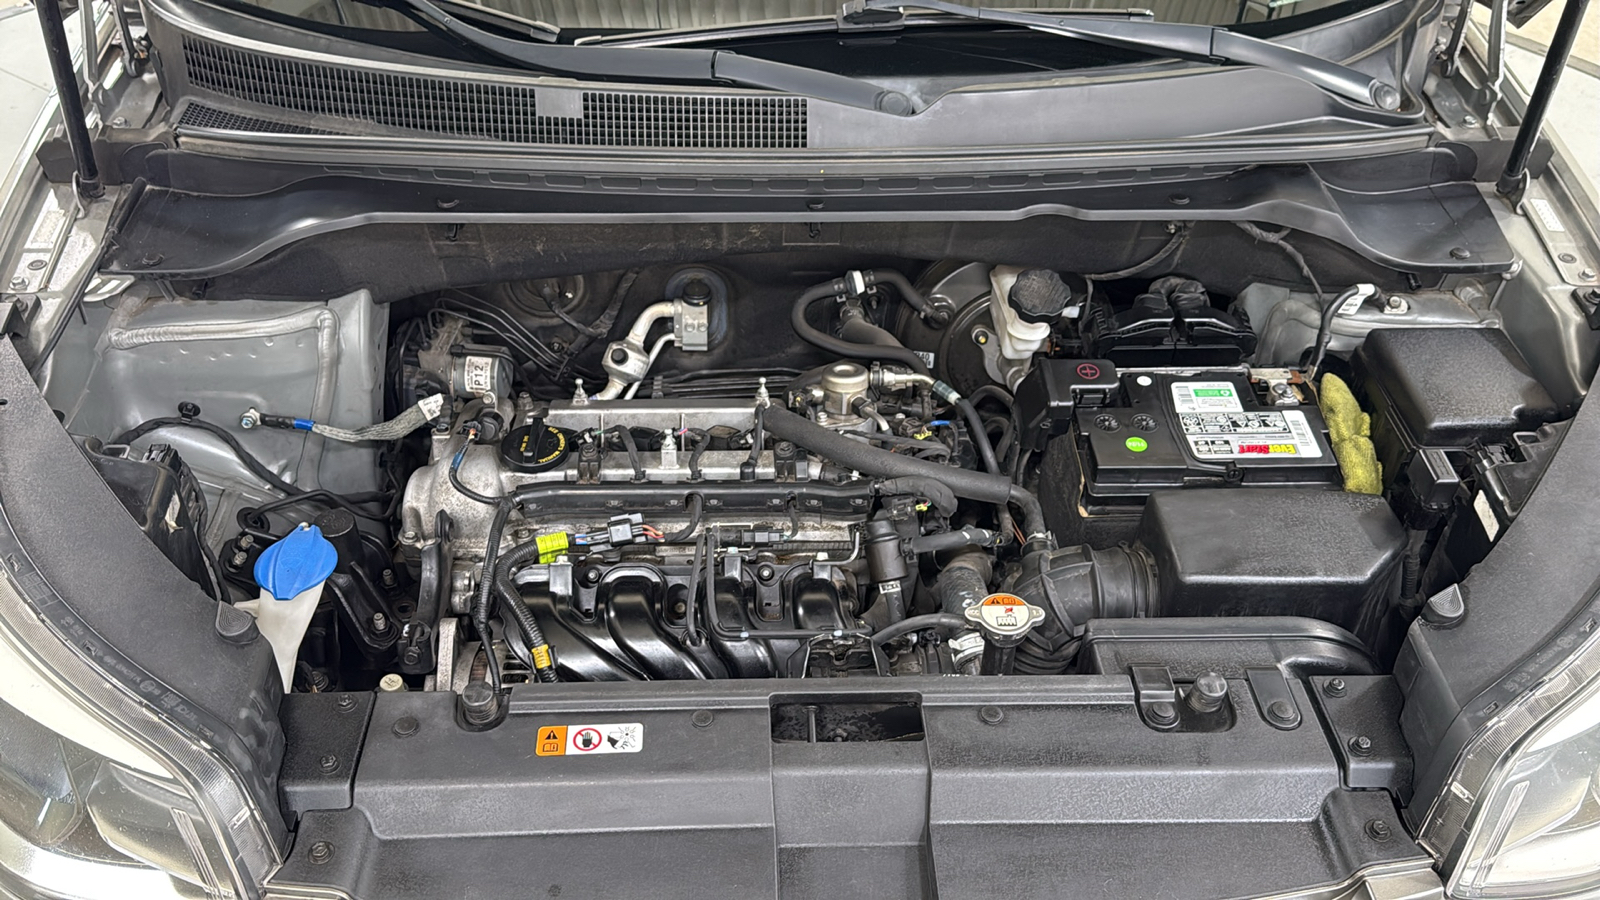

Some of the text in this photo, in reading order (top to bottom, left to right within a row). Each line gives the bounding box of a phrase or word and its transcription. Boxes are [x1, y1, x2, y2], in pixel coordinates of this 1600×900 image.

[474, 365, 484, 387] P12
[537, 426, 566, 463] SEE OWNER'S MANUAL
[1238, 443, 1297, 454] EverStart
